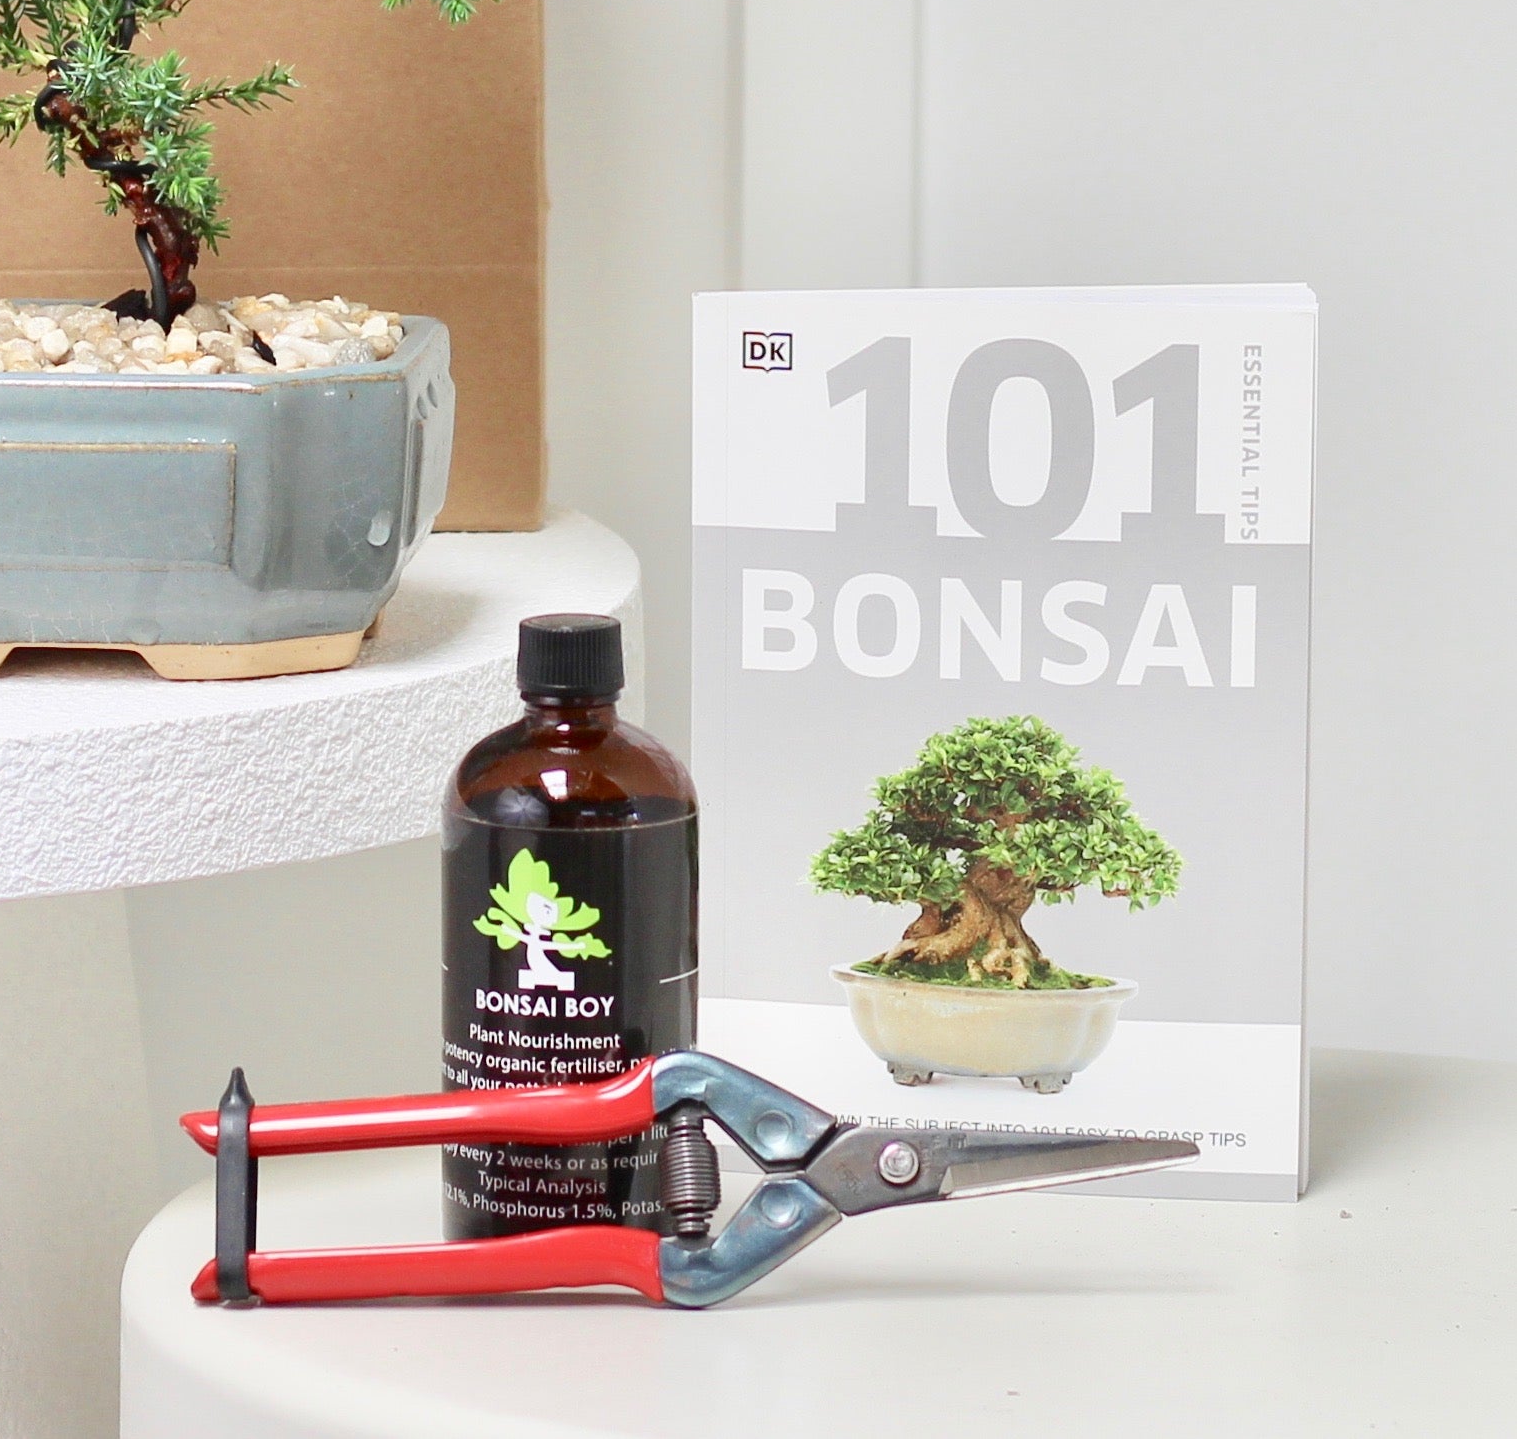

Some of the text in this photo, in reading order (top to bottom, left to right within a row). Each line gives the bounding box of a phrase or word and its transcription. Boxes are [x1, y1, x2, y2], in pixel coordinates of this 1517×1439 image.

[750, 342, 785, 362] DK
[826, 335, 1226, 542] 101
[1240, 344, 1262, 540] ESSENTIAL TIPS
[741, 568, 1257, 688] BONSAI
[475, 988, 614, 1018] BONSAI BOY
[469, 1023, 621, 1050] Plant Nourishment
[445, 1041, 483, 1068] potency
[486, 1056, 546, 1074] organic
[550, 1056, 626, 1075] fertiliser,
[456, 1069, 468, 1086] all
[470, 1075, 501, 1092] your
[1209, 1132, 1247, 1147] TIPS
[459, 1144, 493, 1167] every
[496, 1150, 505, 1166] 2
[509, 1153, 562, 1170] weeks
[567, 1158, 585, 1171] or
[590, 1158, 608, 1171] as
[478, 1170, 607, 1198] Typical Analysis
[473, 1193, 565, 1219] Phosphorus
[572, 1203, 617, 1220] 1.5%,
